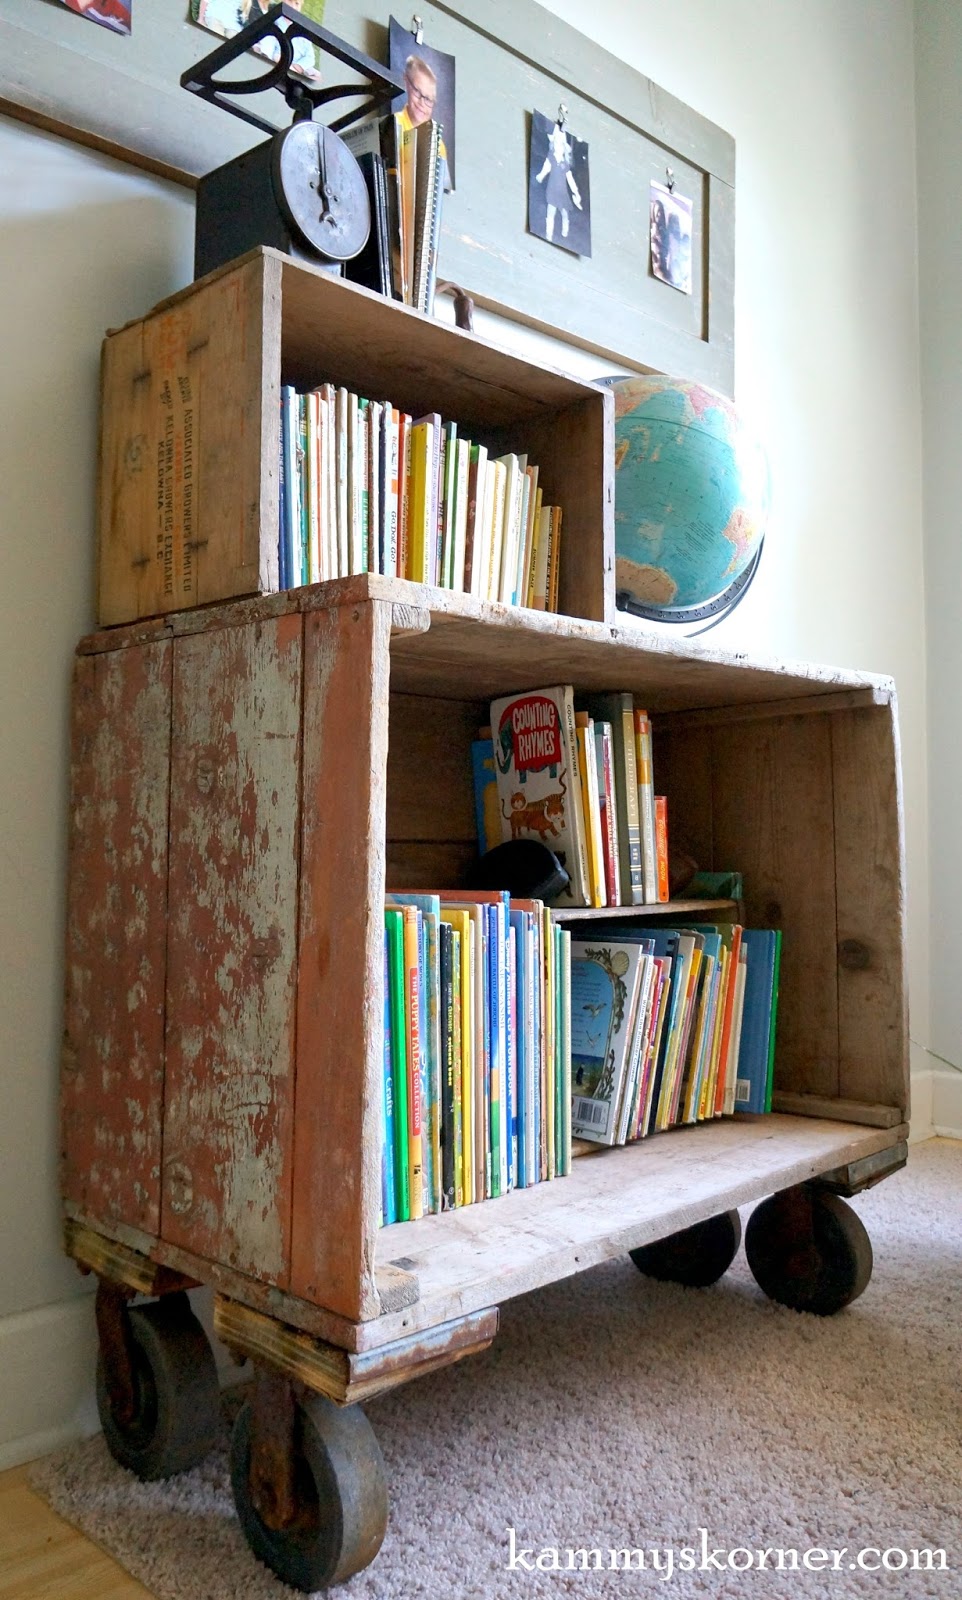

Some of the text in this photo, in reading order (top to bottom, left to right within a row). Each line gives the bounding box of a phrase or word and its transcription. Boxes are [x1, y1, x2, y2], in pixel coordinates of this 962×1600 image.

[183, 408, 193, 480] ASSOCIATED
[157, 441, 165, 510] KELOWNA
[163, 415, 174, 598] KELOWNA GROWERS EXCHANGE
[183, 484, 193, 539] GROWERS
[512, 702, 556, 735] COUNTING
[566, 704, 579, 777] COUNTING RHYMES
[518, 731, 556, 762] RHYMES
[658, 819, 667, 881] GOODNIGHT MOON
[504, 939, 512, 970] Disney
[411, 994, 419, 1033] PUPPY
[507, 1017, 512, 1031] CD
[412, 1036, 420, 1070] TALES
[384, 1076, 394, 1117] Crafts
[413, 1072, 421, 1129] COLLECTION
